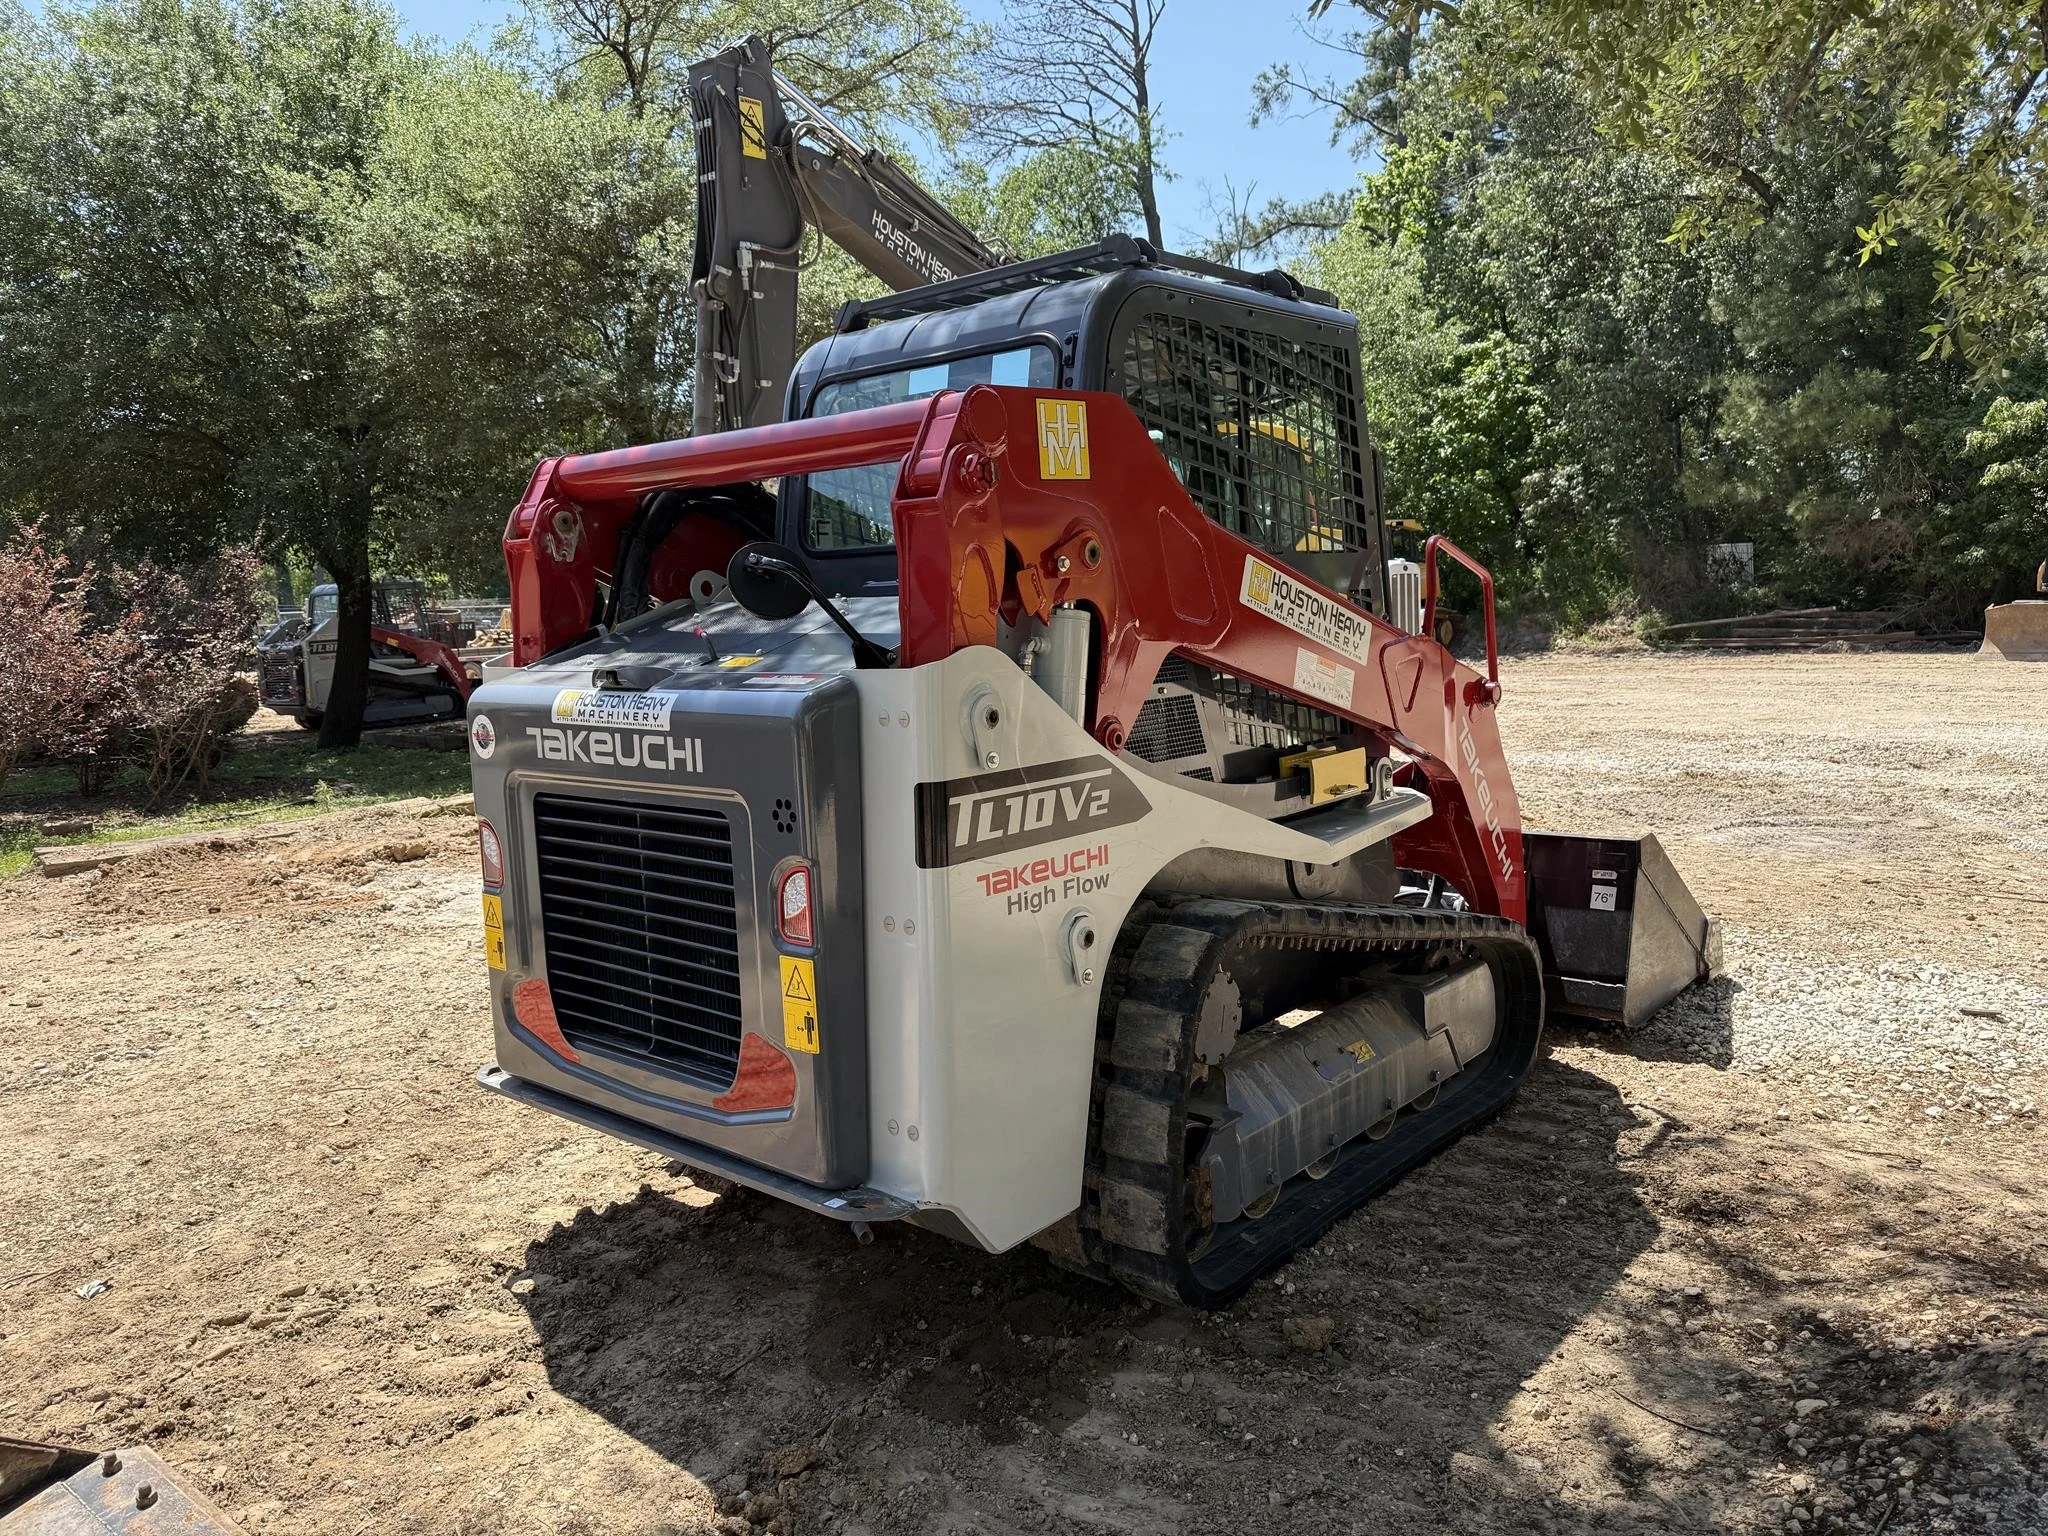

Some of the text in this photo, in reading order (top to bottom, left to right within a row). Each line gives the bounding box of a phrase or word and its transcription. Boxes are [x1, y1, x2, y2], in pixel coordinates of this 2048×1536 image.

[872, 209, 958, 281] HOUSTON HEAV
[875, 230, 938, 284] MACHINE
[1271, 571, 1329, 621] HOUSTON
[1330, 604, 1366, 641] HEAVY
[1274, 599, 1360, 652] MACHINERY
[575, 691, 630, 709] HOUSTON
[628, 694, 671, 711] HEAVY
[577, 708, 660, 723] MACHINERY
[526, 727, 704, 773] TAKEUCHI
[1459, 716, 1514, 882] TAKEUCHI
[976, 844, 1110, 897] TAKEUCHI
[1007, 873, 1110, 915] High Flow
